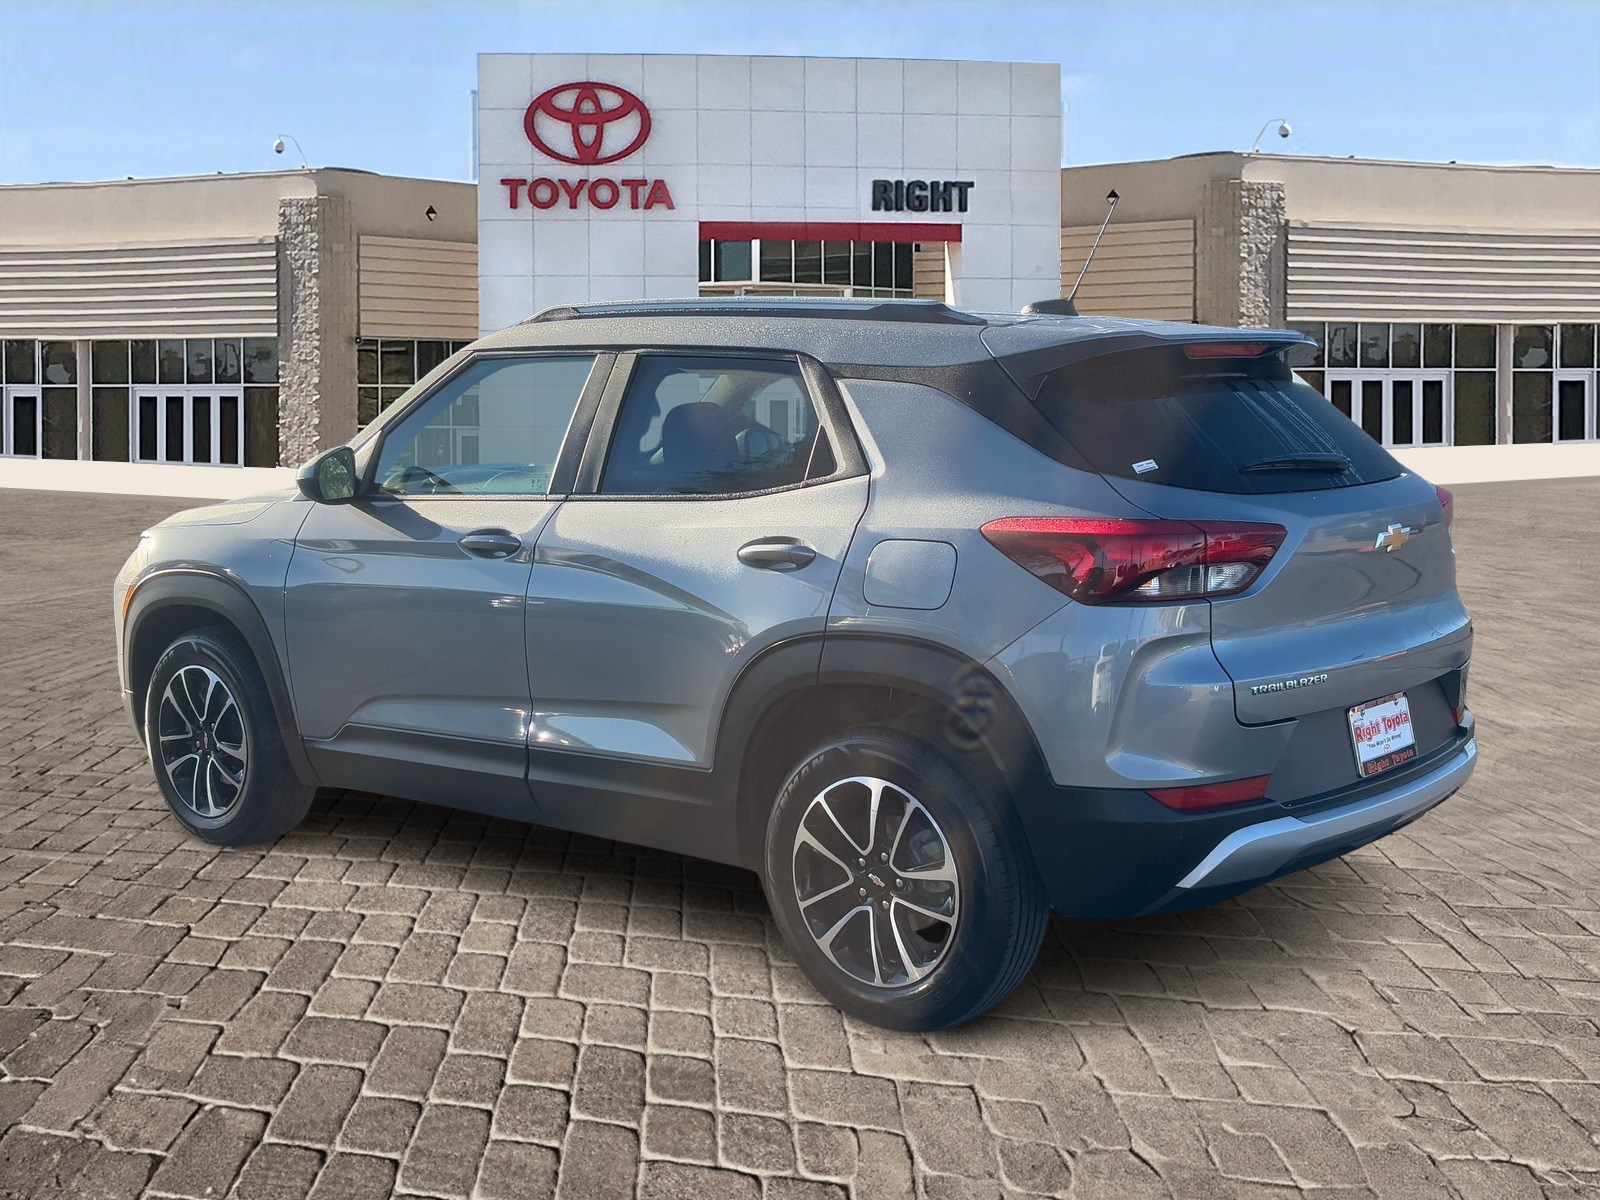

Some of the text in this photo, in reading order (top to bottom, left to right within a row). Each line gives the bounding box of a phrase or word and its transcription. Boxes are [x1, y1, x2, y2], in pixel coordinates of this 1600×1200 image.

[500, 178, 676, 211] TOYOTA
[871, 179, 975, 213] RIGHT
[1250, 674, 1328, 695] TRAILBLAZER
[1353, 711, 1409, 743] Right Toyota
[1367, 749, 1414, 773] Right Toyota
